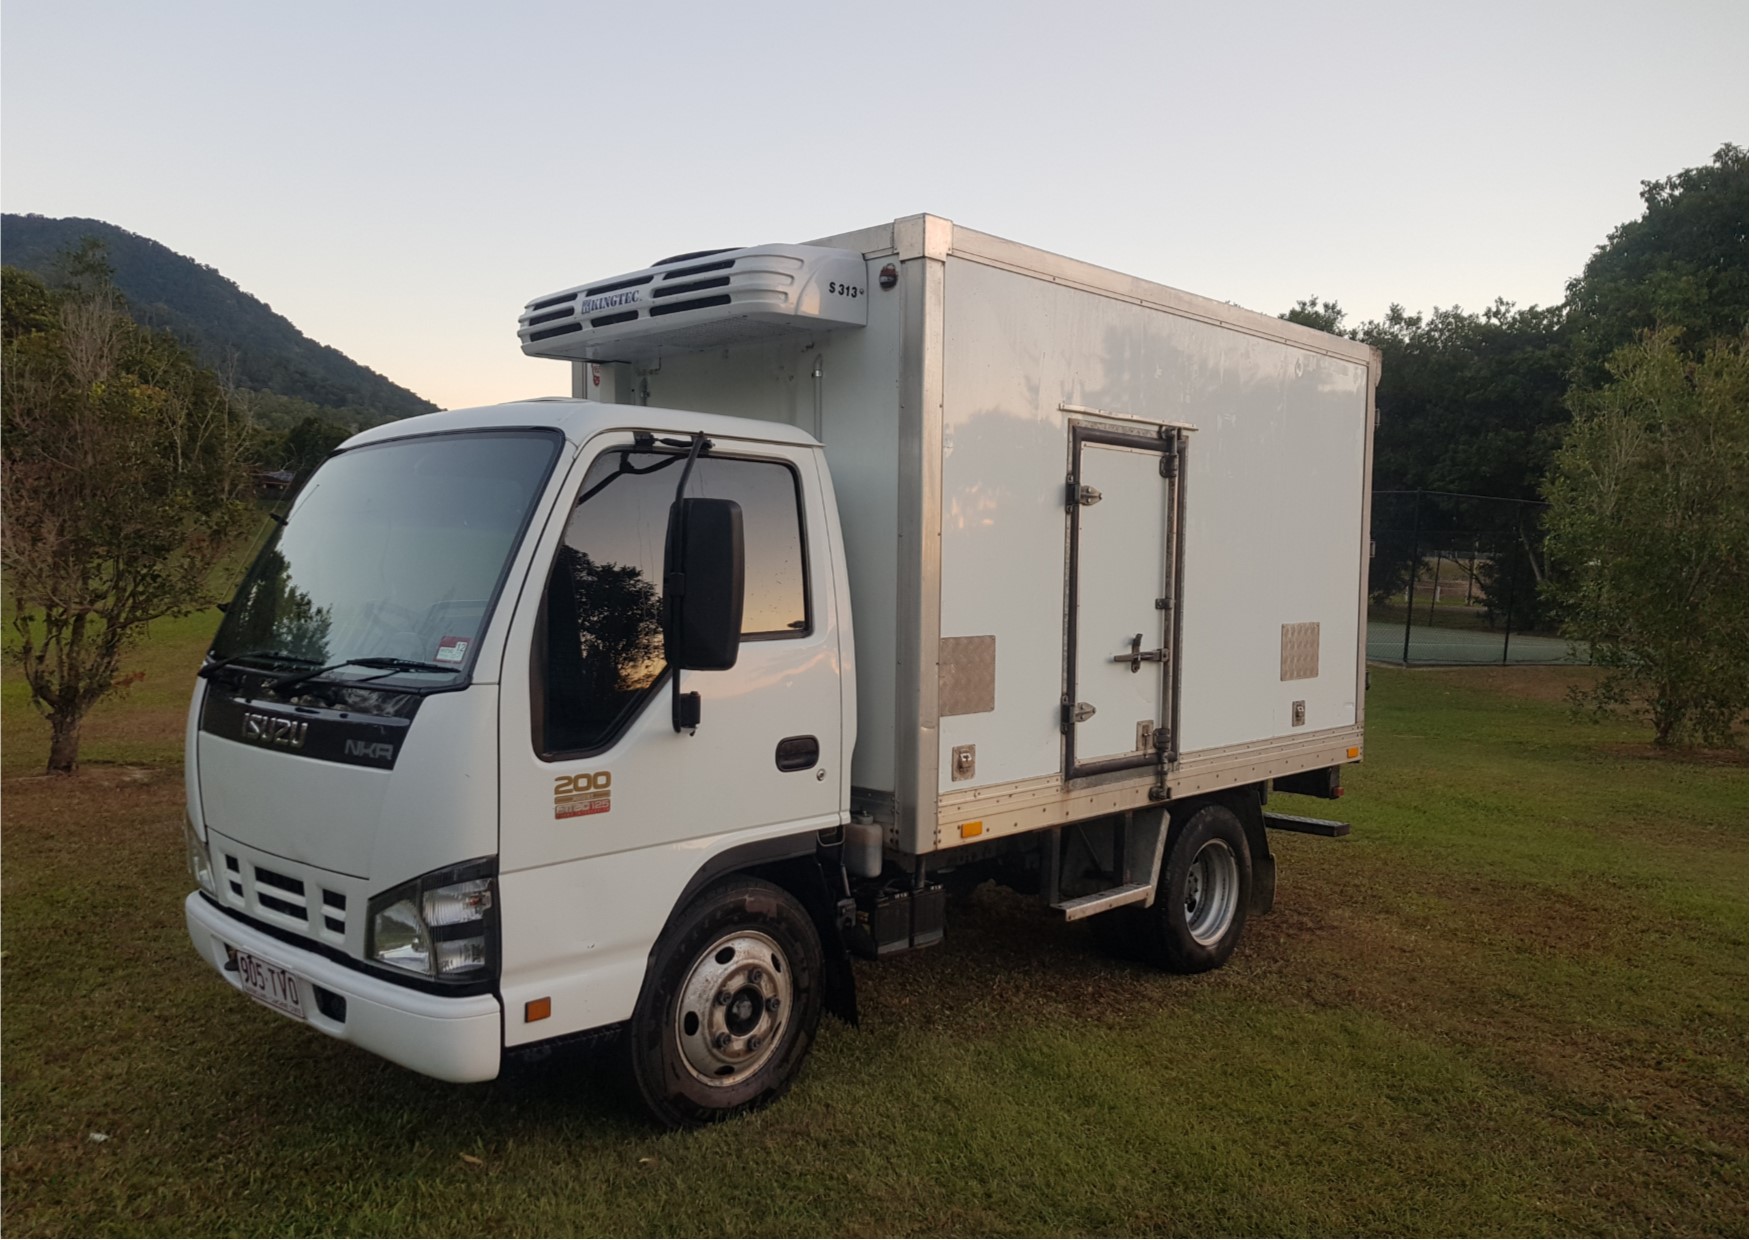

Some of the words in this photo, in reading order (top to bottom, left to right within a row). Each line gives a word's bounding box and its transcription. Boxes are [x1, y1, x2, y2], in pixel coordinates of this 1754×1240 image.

[591, 290, 640, 311] KINGTEC
[828, 281, 836, 294] S
[838, 283, 858, 299] 313
[242, 712, 308, 748] ISUZU
[344, 739, 394, 760] NKR
[554, 771, 611, 795] 200
